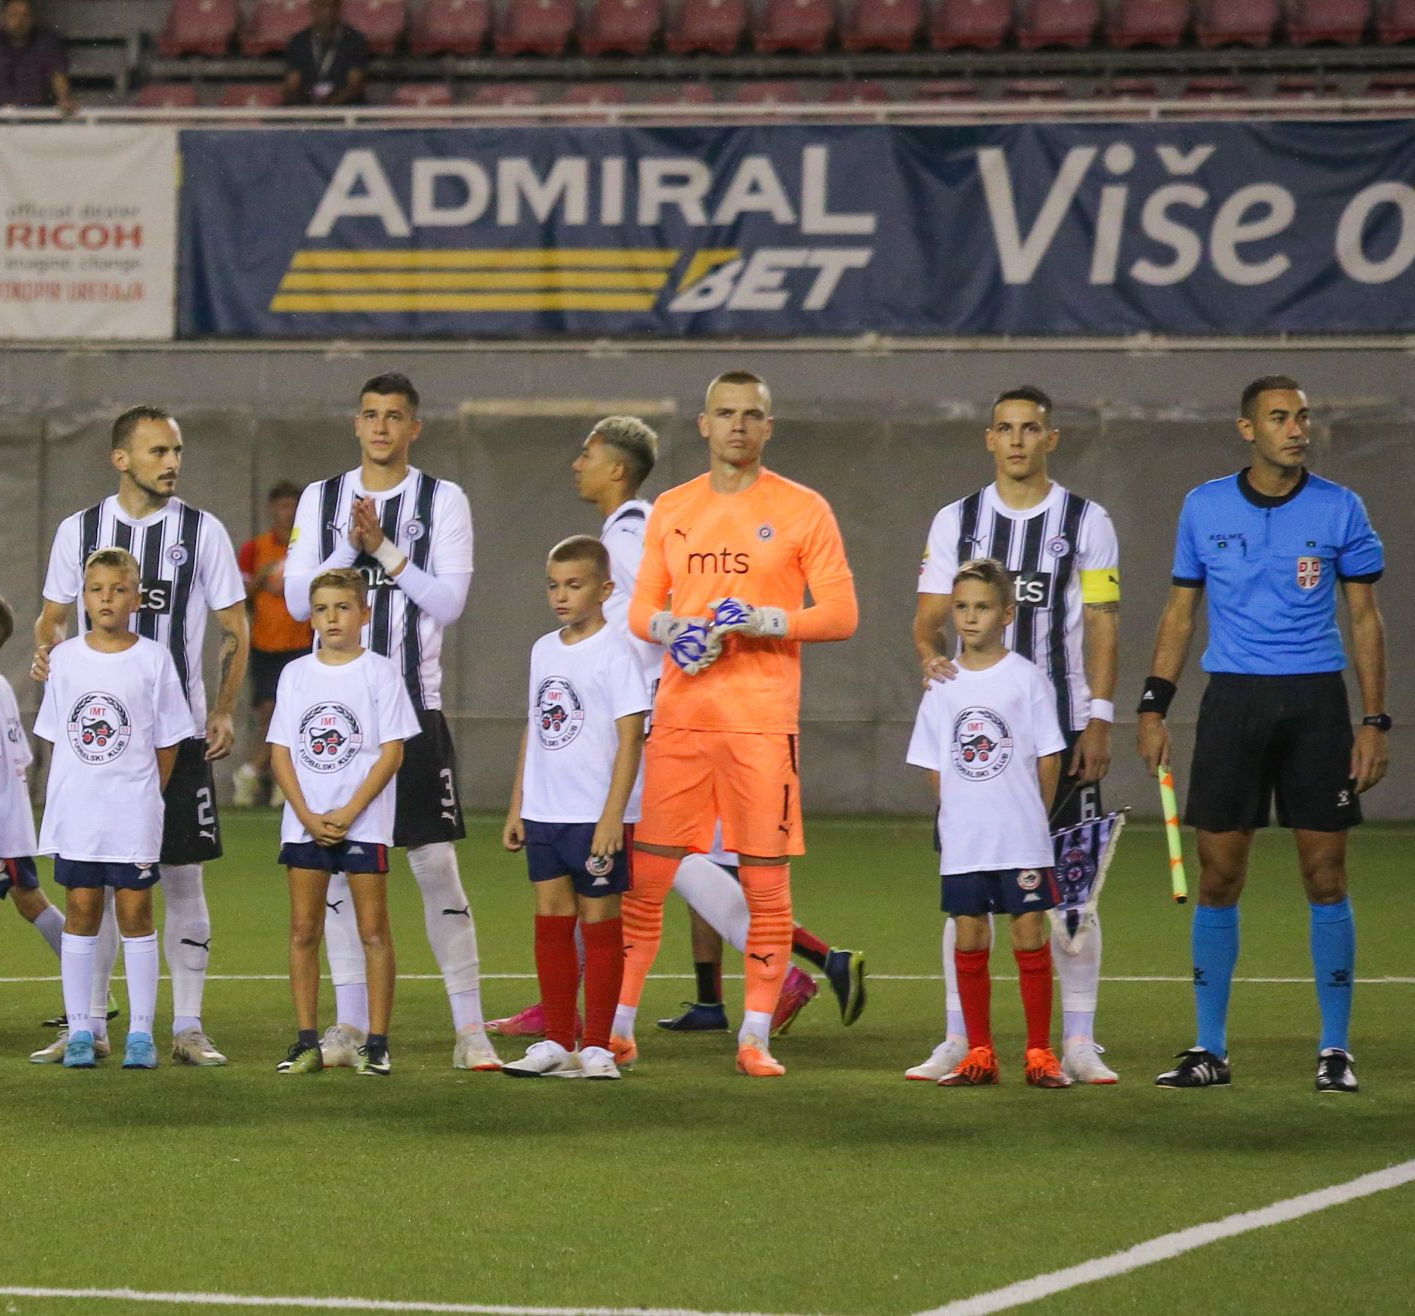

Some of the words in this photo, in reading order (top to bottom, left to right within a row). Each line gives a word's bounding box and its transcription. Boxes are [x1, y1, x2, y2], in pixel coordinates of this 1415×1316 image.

[305, 144, 876, 238] ADMIRAL
[976, 142, 1296, 286] Više
[5, 222, 143, 250] RICOH
[668, 246, 874, 312] BET
[687, 547, 750, 574] mts
[1013, 575, 1044, 603] ts
[548, 691, 562, 701] IMT
[89, 707, 106, 716] IMT
[320, 716, 337, 726] IMT
[967, 722, 984, 732] IMT
[107, 740, 125, 758] KLUB
[439, 768, 455, 807] 3
[196, 787, 214, 826] 2
[783, 784, 789, 821] 1
[1080, 786, 1095, 823] 6
